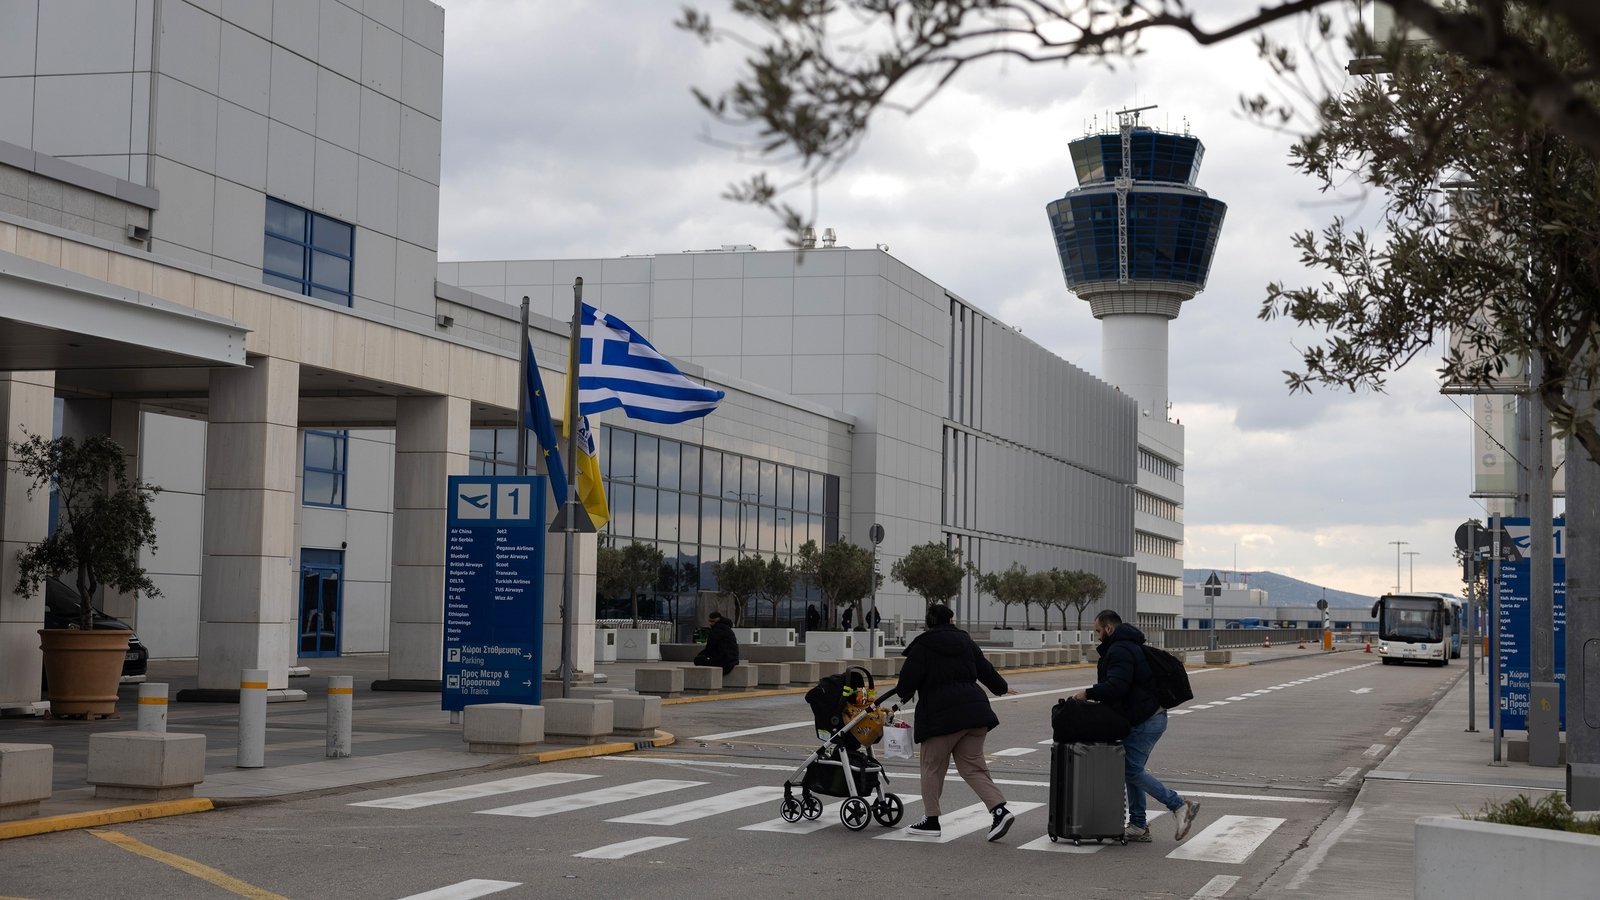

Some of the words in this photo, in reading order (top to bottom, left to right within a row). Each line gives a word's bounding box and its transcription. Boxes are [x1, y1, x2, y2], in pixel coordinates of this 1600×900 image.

[508, 488, 519, 515] 1
[1553, 530, 1561, 554] 1
[462, 656, 484, 666] Parking
[461, 687, 468, 695] To
